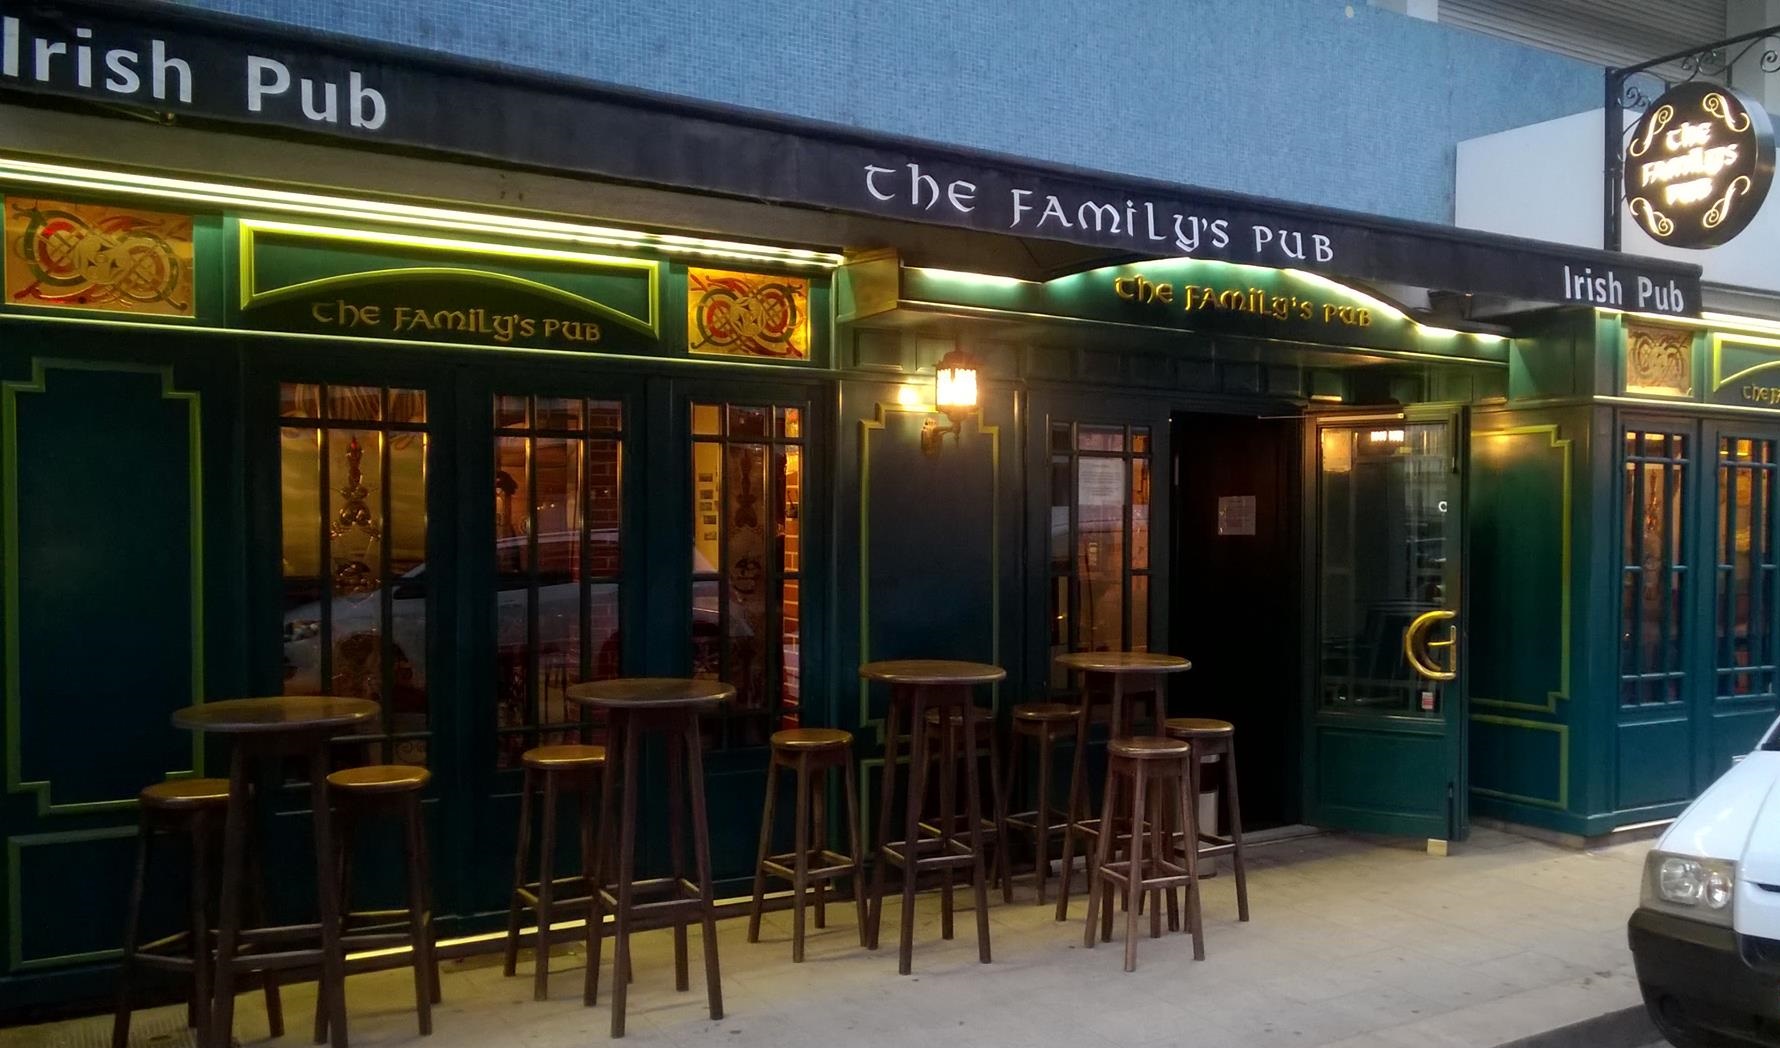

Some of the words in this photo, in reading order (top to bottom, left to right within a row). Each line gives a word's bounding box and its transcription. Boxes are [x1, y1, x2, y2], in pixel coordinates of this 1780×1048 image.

[2, 16, 192, 103] Irish
[247, 54, 387, 131] Pub
[864, 163, 976, 212] The
[1252, 224, 1334, 262] PUB
[1564, 265, 1623, 306] Irish
[1637, 276, 1684, 313] Pub
[543, 318, 600, 342] PUB
[1322, 302, 1373, 328] PUB
